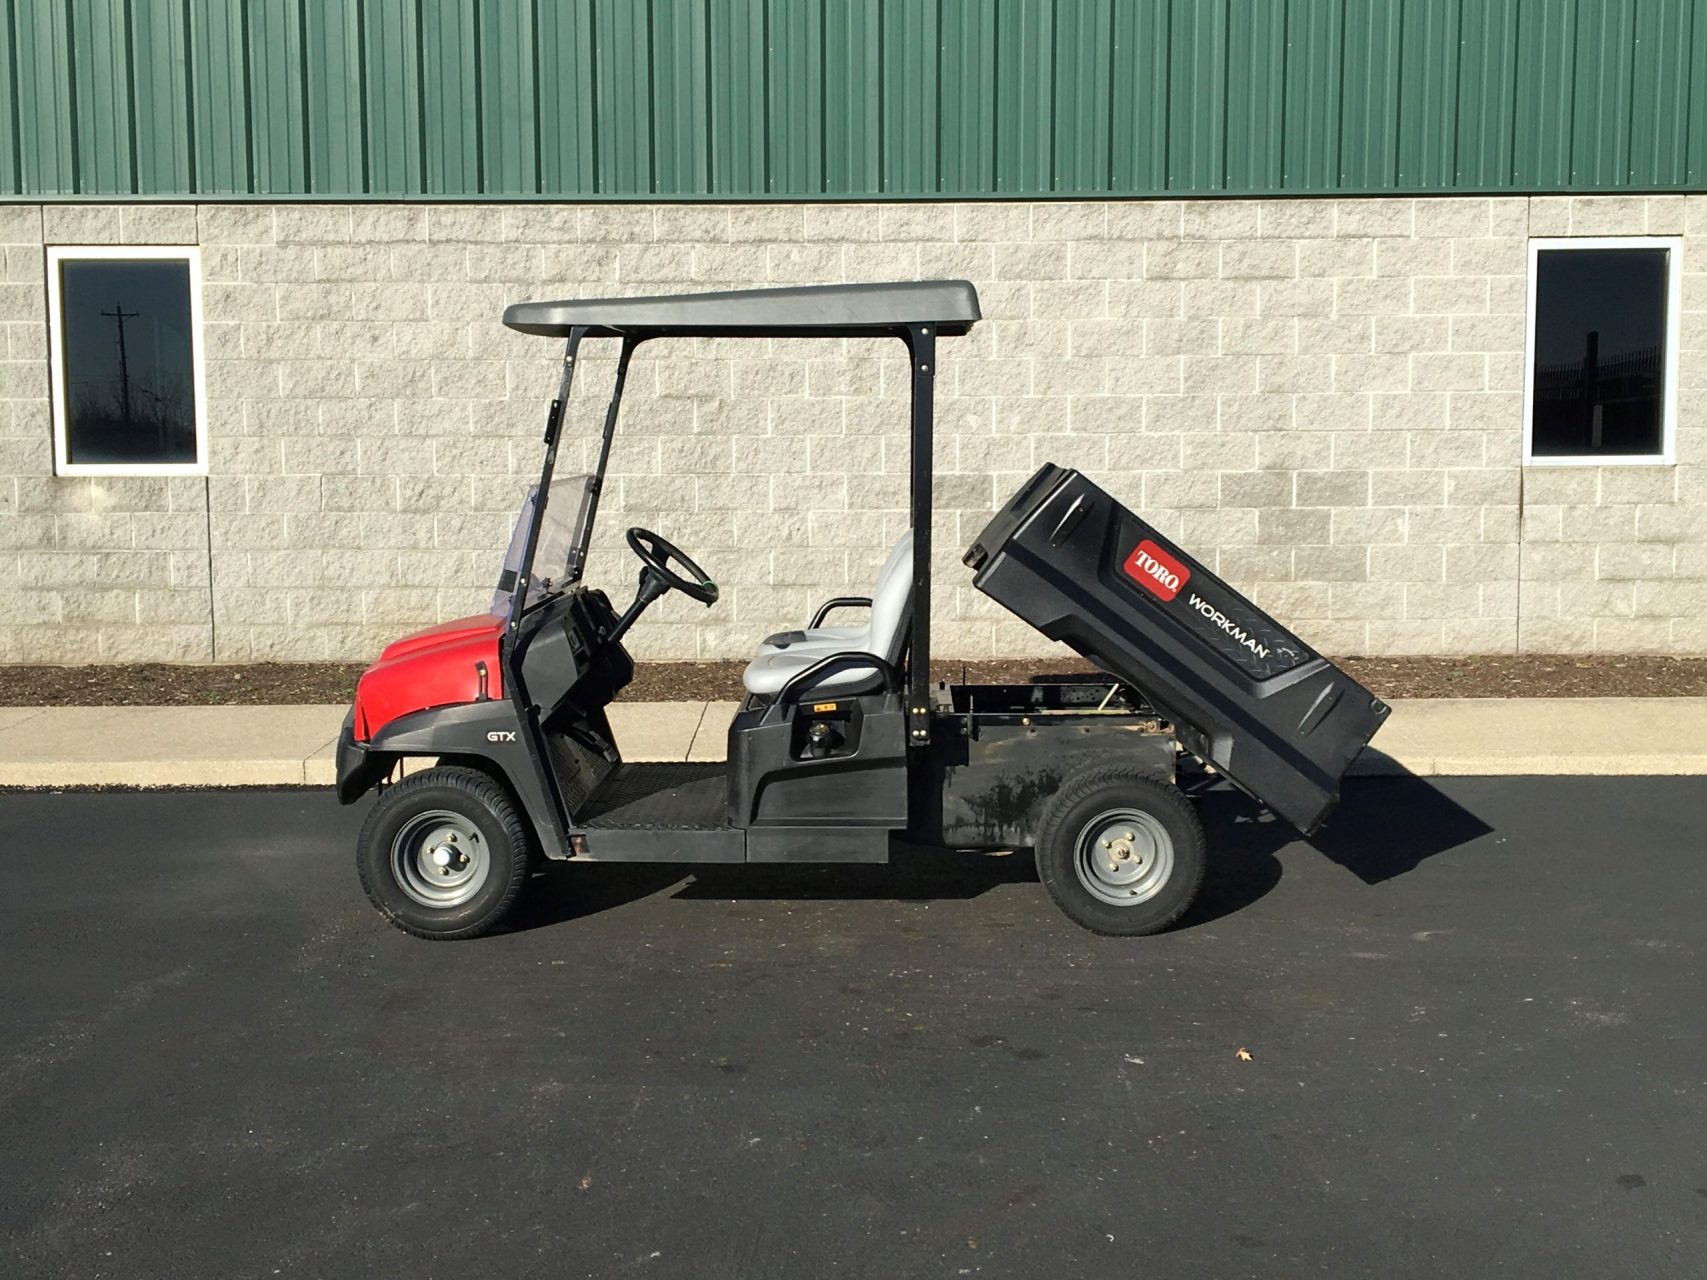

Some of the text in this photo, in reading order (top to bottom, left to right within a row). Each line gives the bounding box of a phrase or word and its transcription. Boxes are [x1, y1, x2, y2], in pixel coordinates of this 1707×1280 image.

[1134, 550, 1179, 591] TORO
[1189, 593, 1269, 659] WORKMAN
[487, 731, 516, 742] GTX
